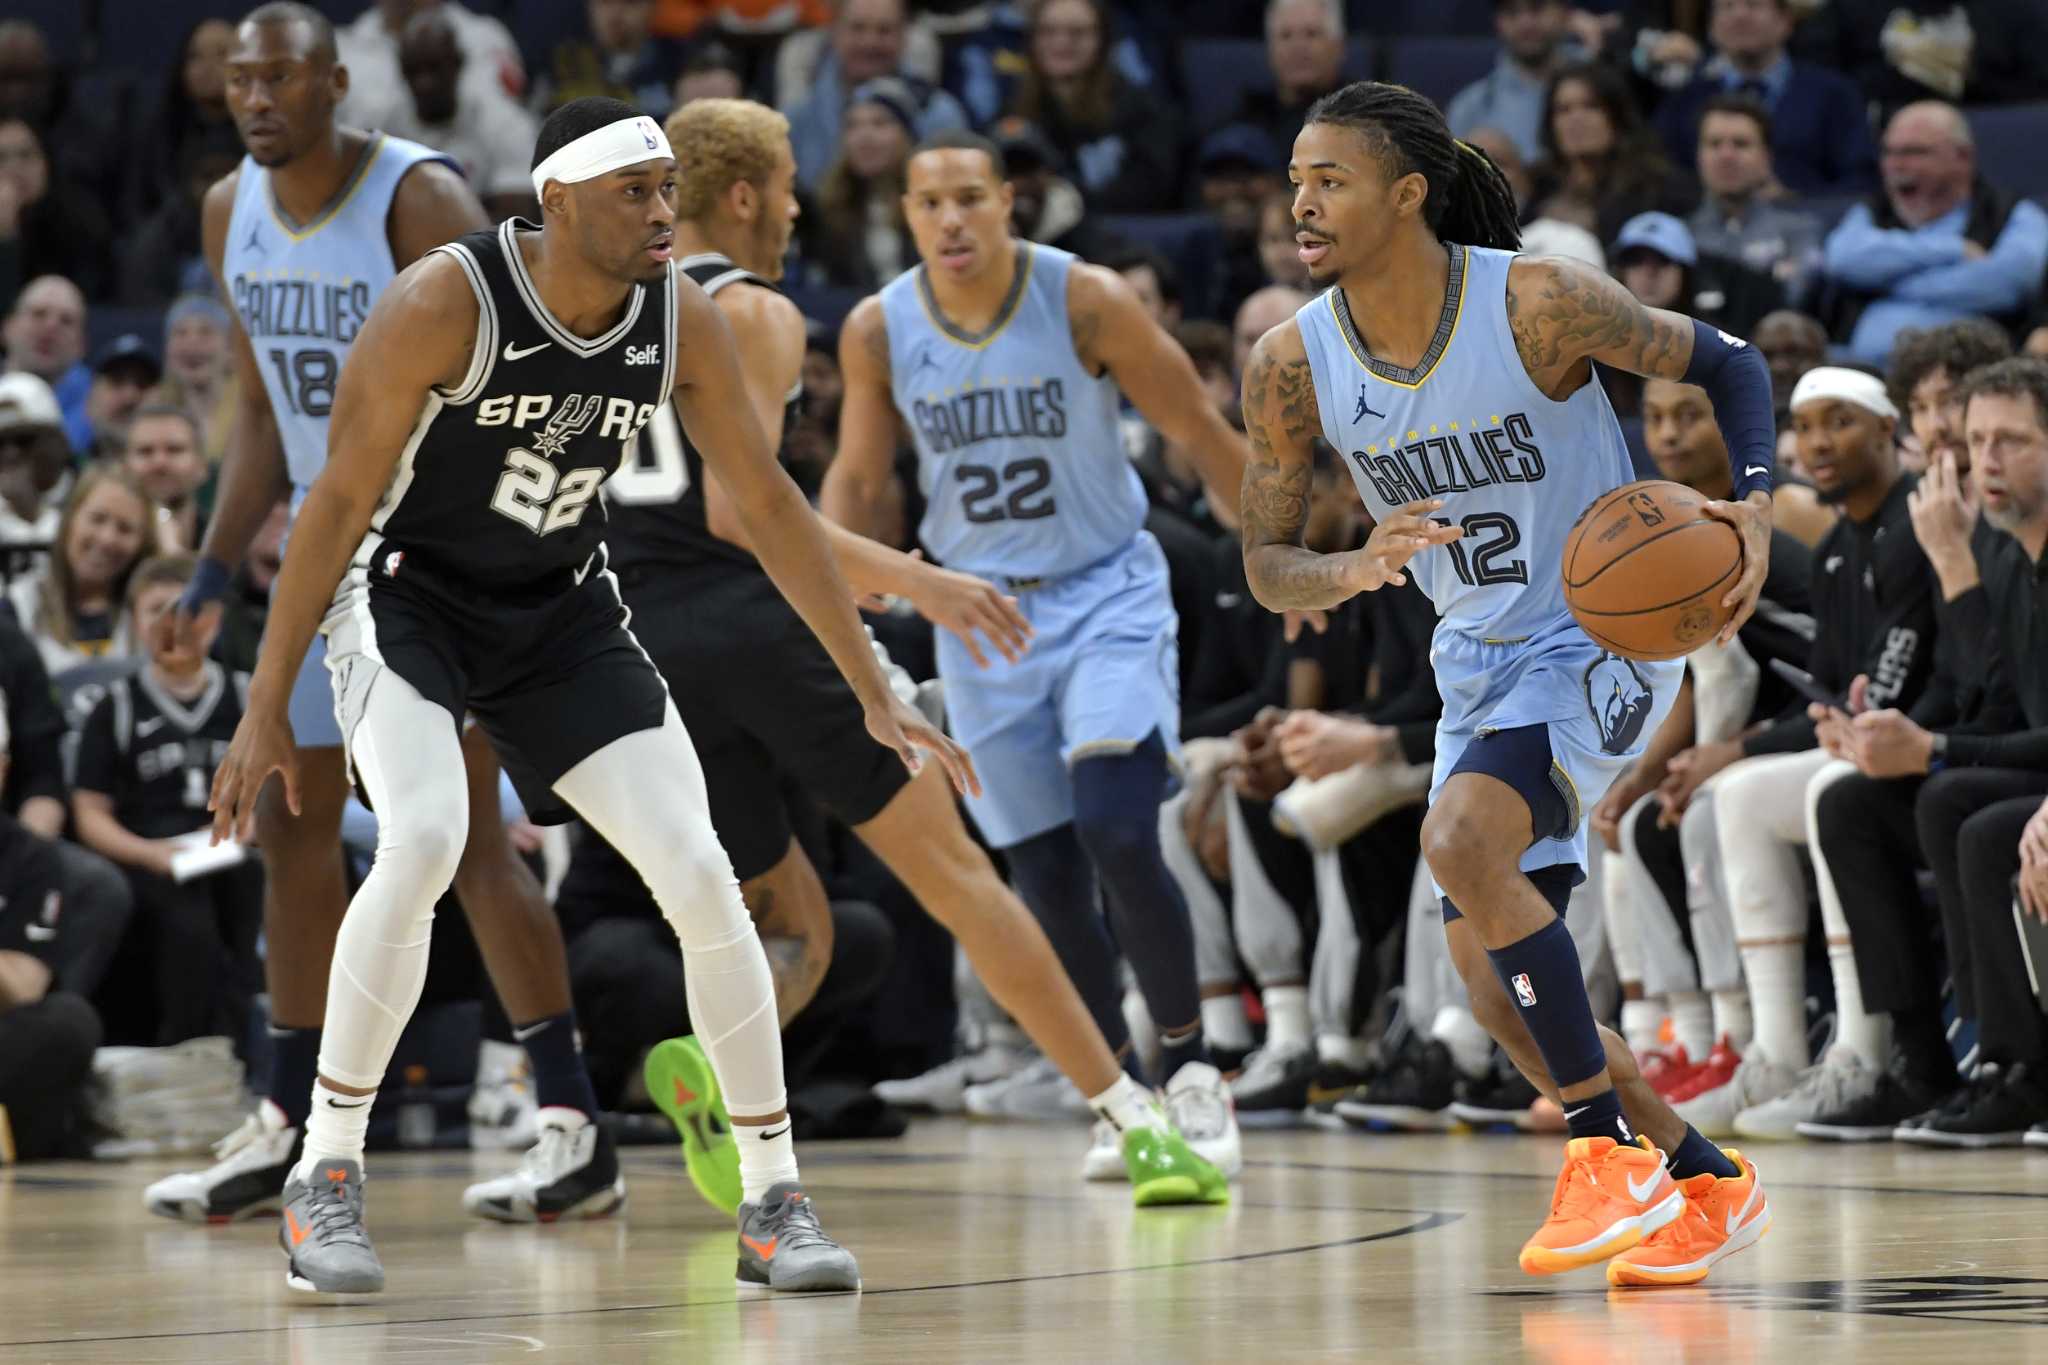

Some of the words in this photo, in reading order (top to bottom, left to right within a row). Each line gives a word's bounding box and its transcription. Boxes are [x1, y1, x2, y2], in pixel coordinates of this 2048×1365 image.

[268, 348, 338, 418] 18
[624, 344, 661, 366] Self.
[914, 377, 1067, 454] GRIZZLIES
[489, 446, 608, 538] 22
[954, 456, 1058, 524] 22
[1352, 412, 1547, 507] GRIZZLIES
[1429, 511, 1530, 587] 12
